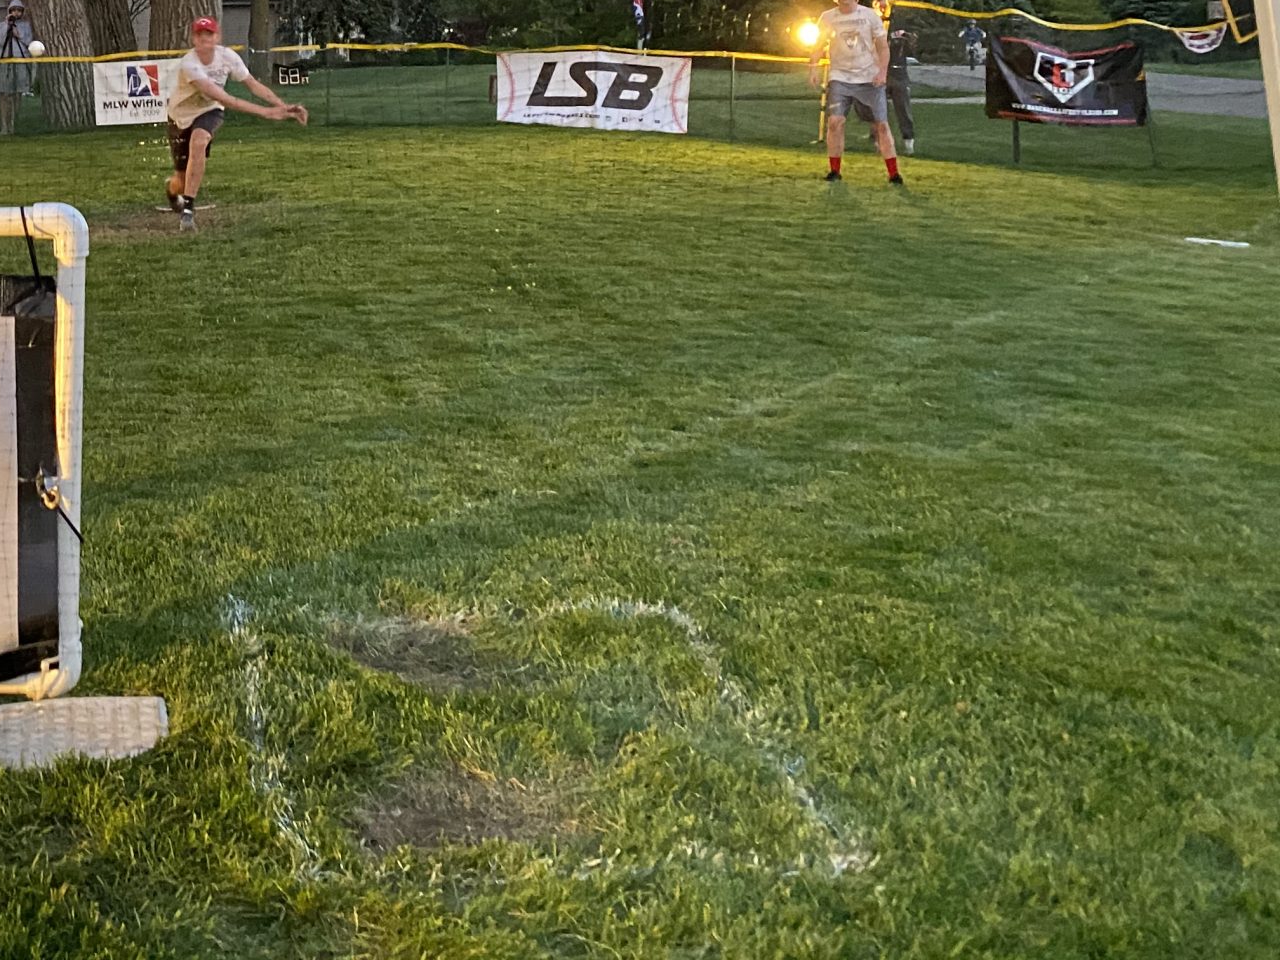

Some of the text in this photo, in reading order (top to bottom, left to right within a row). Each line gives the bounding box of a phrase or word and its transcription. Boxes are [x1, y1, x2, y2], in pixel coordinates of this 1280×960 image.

[279, 66, 300, 85] 68
[526, 61, 664, 111] LSB
[103, 100, 129, 110] MLW
[131, 98, 164, 108] Wiffle
